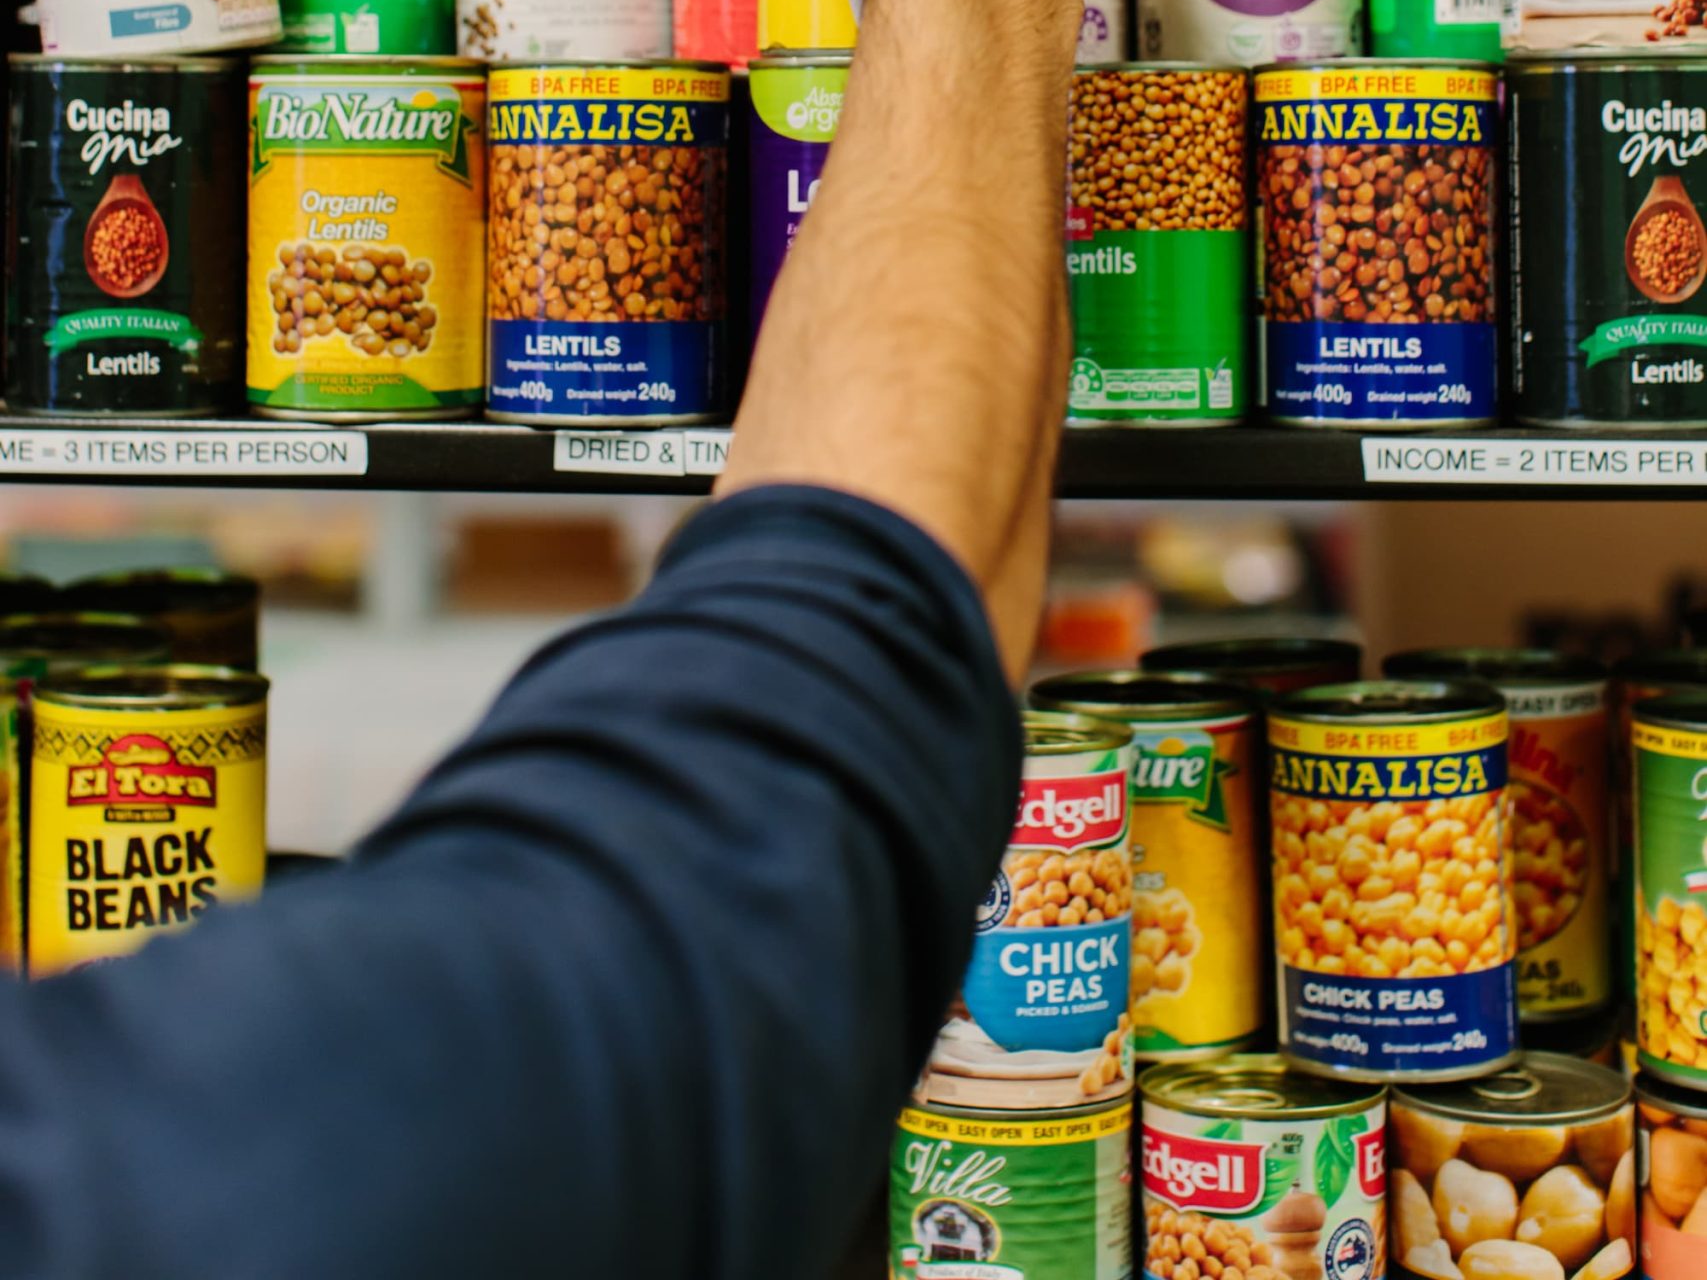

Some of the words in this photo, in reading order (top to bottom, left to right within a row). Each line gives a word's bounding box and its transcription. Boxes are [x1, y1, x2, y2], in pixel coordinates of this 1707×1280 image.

[531, 77, 564, 95] BPA
[570, 76, 620, 95] FREE
[653, 78, 686, 96] BPA
[691, 79, 722, 98] FREE
[1321, 76, 1358, 94] BPA
[1365, 76, 1416, 93] FREE
[1447, 77, 1474, 95] BPA
[67, 98, 170, 137] Cucina
[264, 92, 453, 141] BioNature
[1261, 102, 1482, 141] ANNALISA
[1602, 100, 1706, 140] Cucina
[81, 131, 182, 175] Mia
[301, 190, 398, 218] Organic
[308, 218, 388, 241] Lentils
[1066, 246, 1137, 274] entils
[65, 315, 123, 335] QUALITY
[128, 315, 180, 333] ITALIAN
[1606, 321, 1668, 343] QUALITY
[525, 335, 621, 357] LENTILS
[1320, 337, 1422, 359] LENTILS
[87, 352, 160, 376] Lentils
[1632, 358, 1704, 384] Lentils
[320, 385, 374, 395] PRODUCT
[352, 375, 403, 384] ORGANIC
[520, 381, 553, 402] 400g
[566, 389, 603, 400] Drained
[638, 382, 676, 403] 240g
[1314, 384, 1352, 405] 400g
[1367, 391, 1405, 402] Drained
[1438, 384, 1471, 404] 240g
[64, 441, 79, 463] 3
[87, 441, 166, 464] ITEMS
[176, 441, 228, 464] PER
[238, 441, 347, 464] PERSON
[569, 438, 650, 462] DRIED
[659, 441, 675, 463] &
[1377, 448, 1486, 471] INCOME
[1519, 449, 1535, 471] 2
[1544, 450, 1628, 473] ITEMS
[1638, 451, 1693, 473] PER
[1325, 731, 1361, 750] BPA
[1366, 732, 1418, 750] FREE
[70, 768, 108, 798] El
[114, 767, 212, 798] Tora
[1272, 753, 1487, 797] ANNALISA
[1015, 783, 1120, 838] dgell
[67, 827, 214, 882] BLACK
[68, 876, 217, 932] BEANS
[1000, 934, 1119, 976] CHICK
[1026, 975, 1103, 1004] PEAS
[1303, 982, 1373, 1010] CHICK
[1378, 989, 1445, 1010] PEAS
[1016, 1006, 1059, 1017] PICKED
[958, 1124, 987, 1139] EASY
[991, 1126, 1022, 1140] OPEN
[1033, 1126, 1062, 1140] EASY
[1065, 1122, 1091, 1136] OPEN
[905, 1140, 1012, 1207] Villa
